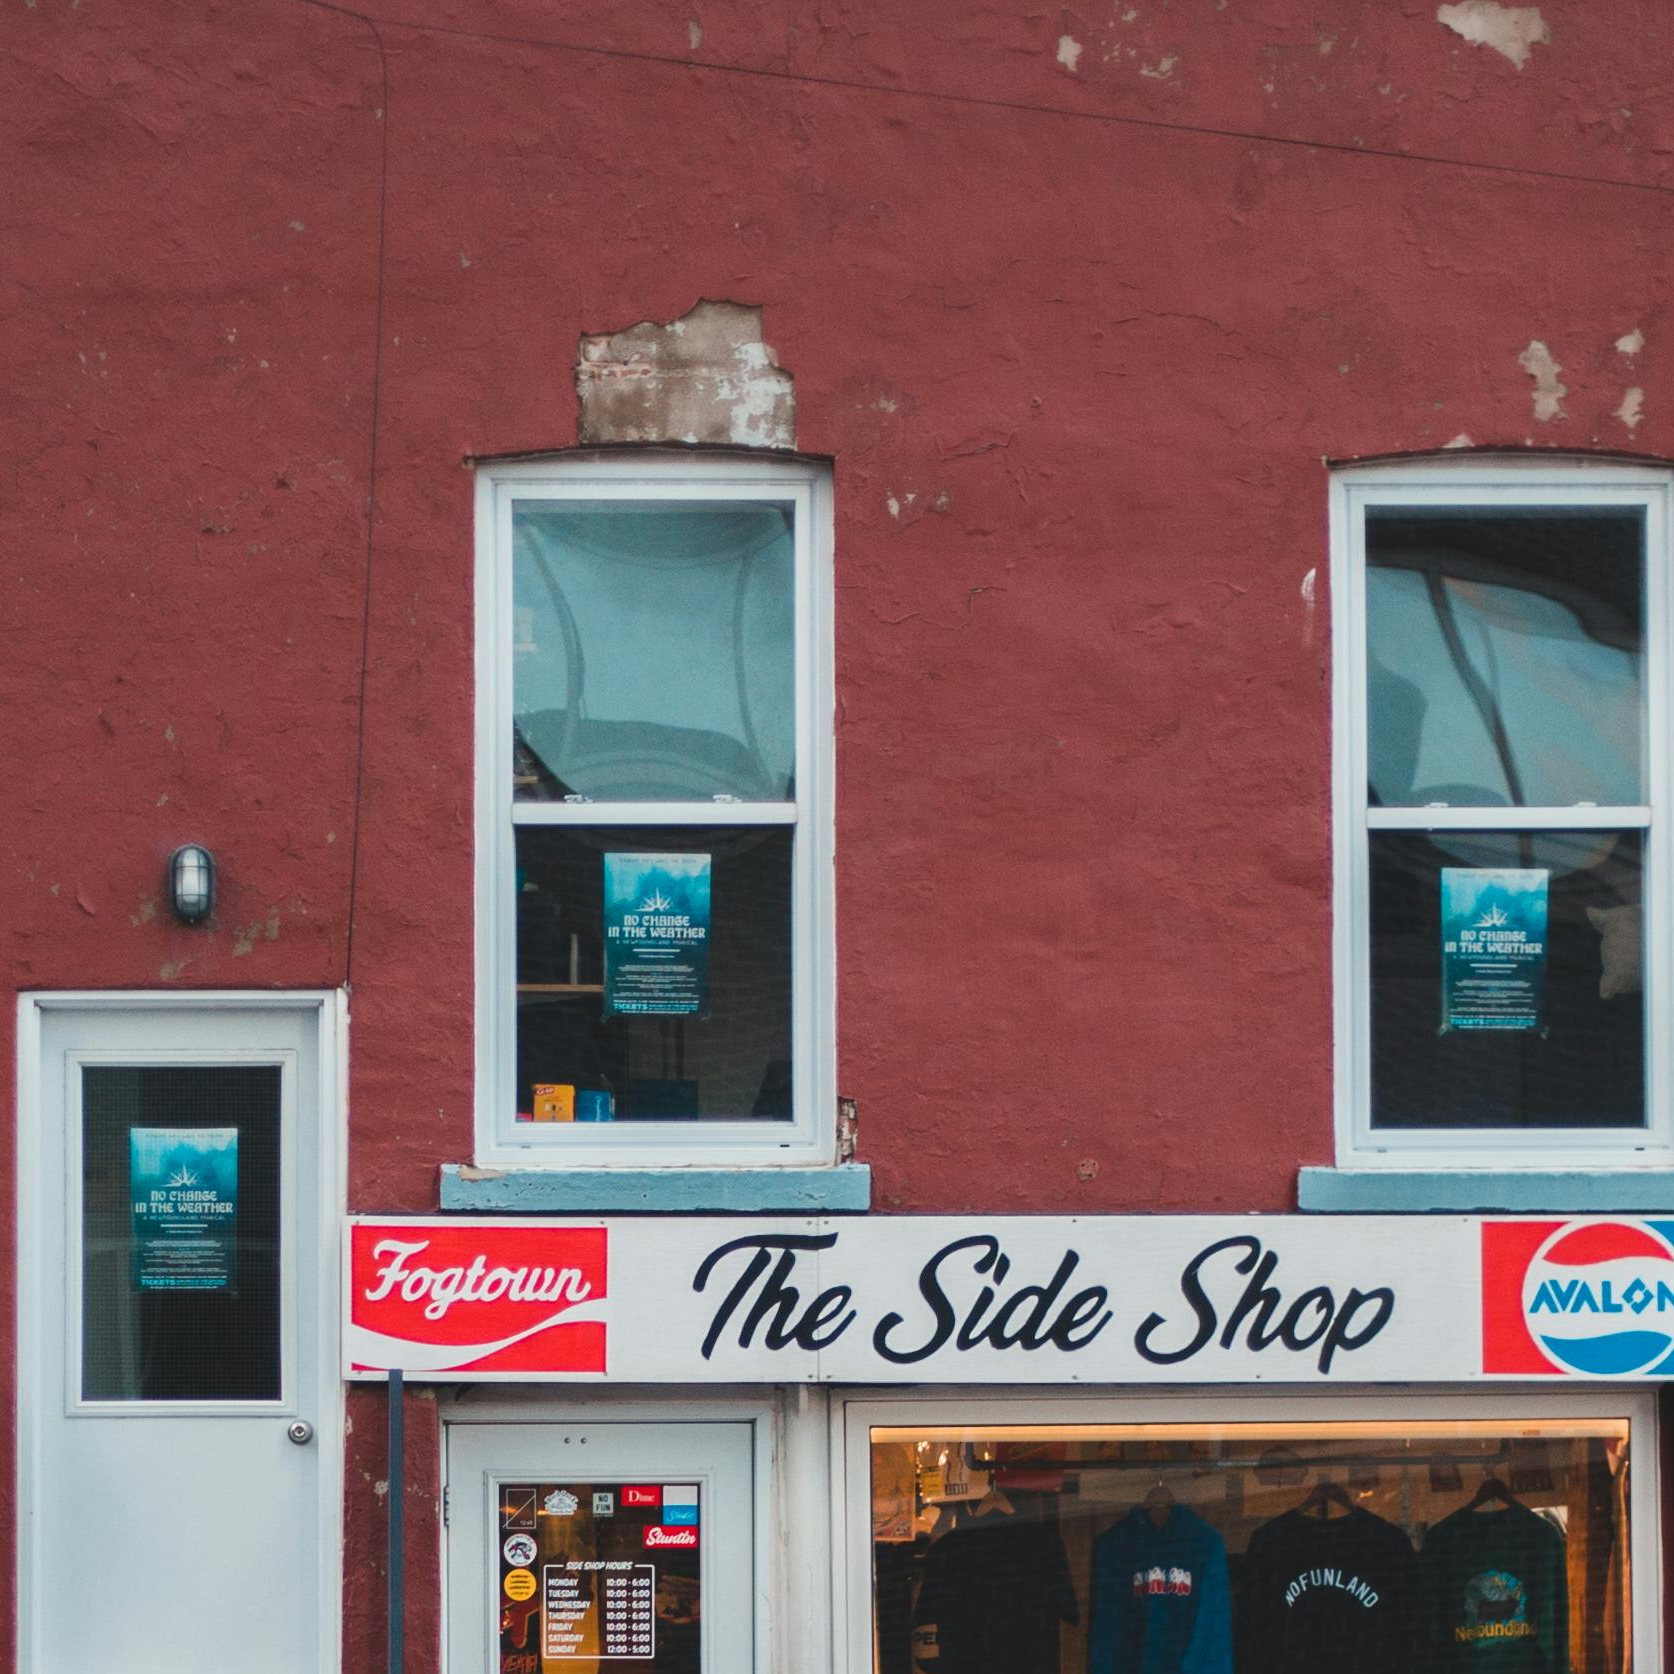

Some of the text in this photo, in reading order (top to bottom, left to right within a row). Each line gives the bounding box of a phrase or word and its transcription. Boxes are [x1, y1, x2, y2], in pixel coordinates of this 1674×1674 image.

[623, 914, 690, 927] NO CHANGE
[608, 926, 706, 938] IN THE WEATHER
[1461, 930, 1527, 942] NO CHANGE
[1445, 941, 1543, 953] IN THE WEATHER
[150, 1190, 218, 1201] NO CHANGE
[135, 1202, 233, 1213] IN THE WEATHER
[365, 1239, 591, 1320] Fogtown
[692, 1232, 1396, 1375] The Side Shop
[598, 1494, 609, 1503] NO
[628, 1490, 656, 1502] Dime
[596, 1503, 611, 1511] FUN
[566, 1561, 633, 1570] SIDE SHOP HOURS
[548, 1578, 579, 1586] MONDAY
[606, 1578, 627, 1586] 10:00
[632, 1578, 650, 1586] 6:00
[1285, 1568, 1379, 1608] NOFUNLAND
[548, 1590, 579, 1598] TUESDAY
[606, 1590, 627, 1598] 10:00
[632, 1590, 650, 1598] 6:00
[548, 1601, 591, 1609] WEDNESDAY
[606, 1601, 627, 1609] 10:00
[632, 1601, 650, 1609] 6:00
[548, 1612, 585, 1620] THURSDAY
[606, 1612, 627, 1620] 10:00
[632, 1612, 650, 1620] 6:00
[548, 1623, 573, 1631] FRIDAY
[606, 1623, 627, 1631] 10:00
[632, 1623, 650, 1631] 6:00
[548, 1634, 584, 1642] SATURDAY
[606, 1634, 627, 1642] 10:00
[632, 1634, 650, 1642] 6:00
[548, 1645, 576, 1653] SUNDAY
[607, 1645, 627, 1653] 12:00
